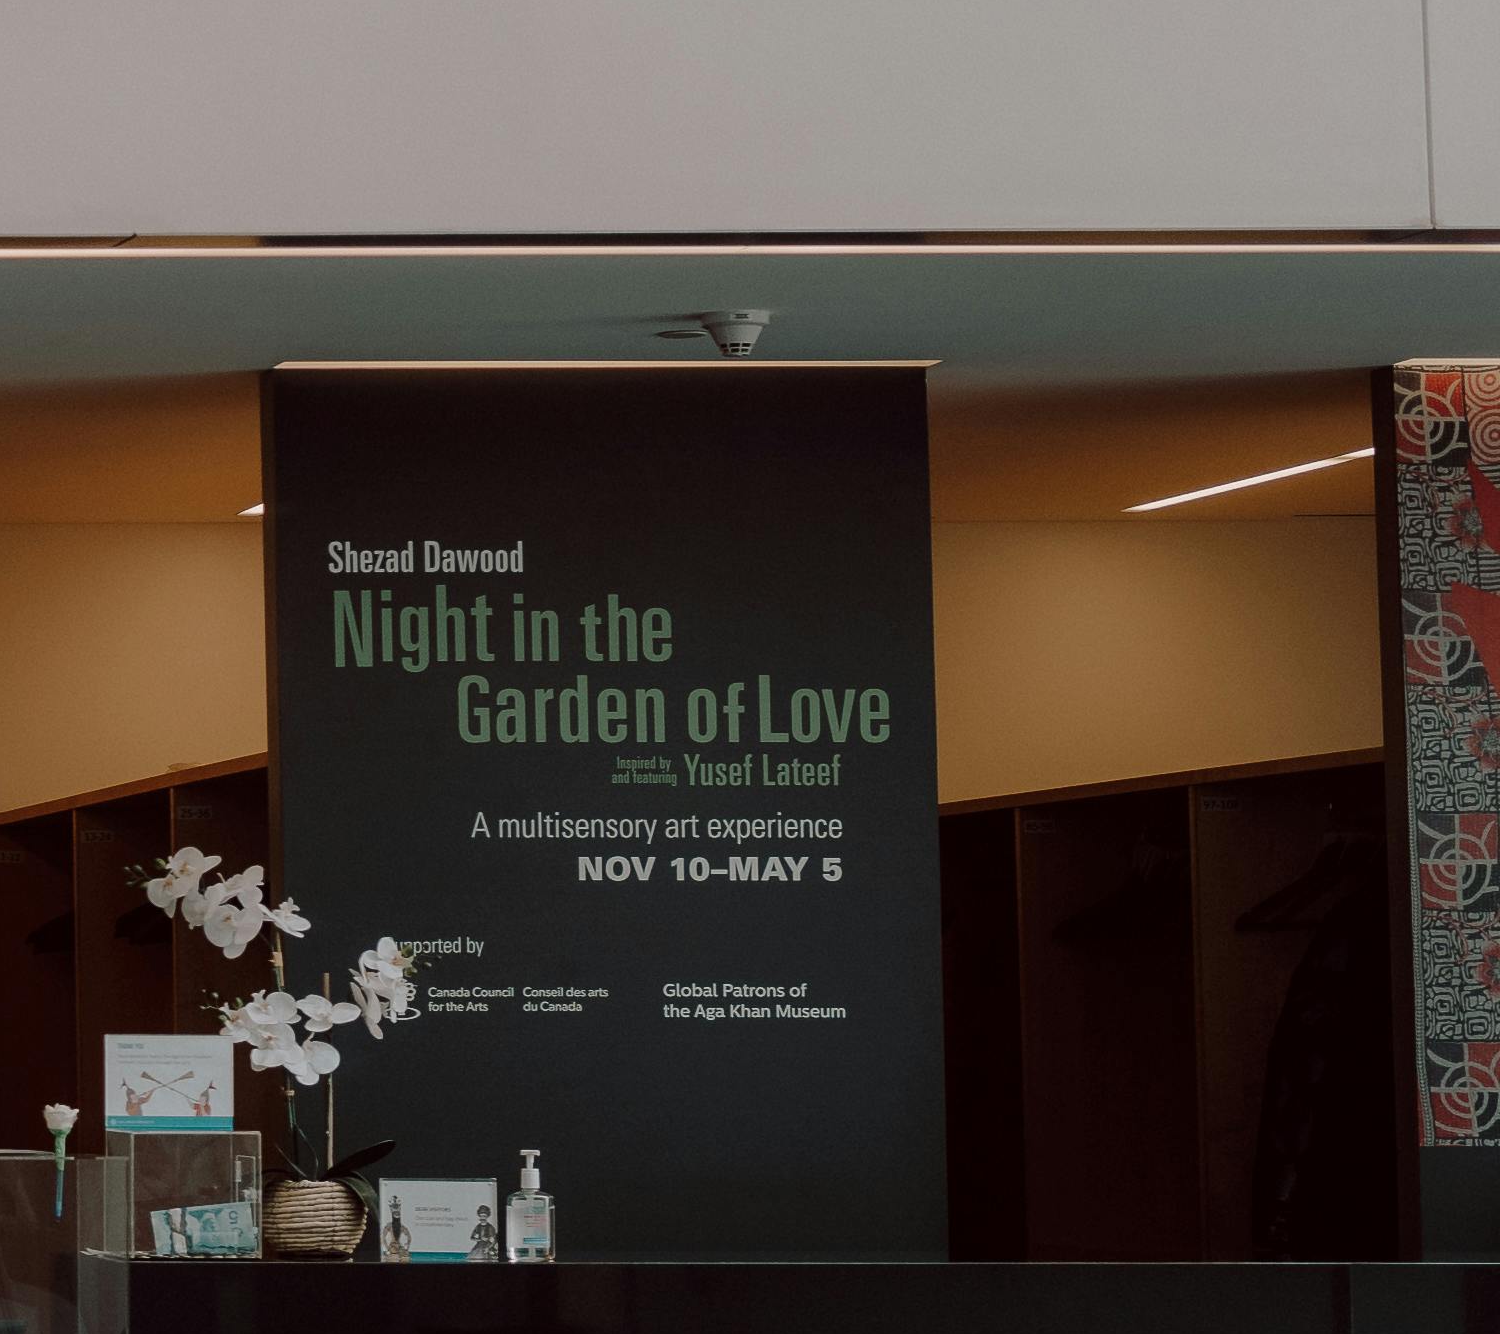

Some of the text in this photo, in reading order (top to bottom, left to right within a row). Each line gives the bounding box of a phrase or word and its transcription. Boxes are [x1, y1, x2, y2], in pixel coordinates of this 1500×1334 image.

[328, 541, 524, 574] Shezad Dawood
[334, 584, 673, 673] Night in the
[457, 674, 891, 744] Garden of Love
[617, 755, 672, 773] Inspired by
[684, 753, 841, 787] Yusef Lateef
[612, 769, 678, 787] and featuring
[471, 811, 843, 845] A multisensory art experience
[578, 855, 656, 882] NOV
[822, 857, 843, 882] 5
[466, 936, 485, 958] by
[428, 986, 515, 998] Canada Council
[522, 986, 609, 998] Conseil des arts
[662, 982, 808, 998] Global Patrons of
[428, 1001, 489, 1012] for the Arts
[522, 1001, 583, 1012] du Canada
[663, 1003, 847, 1021] the Aga Khan Museum
